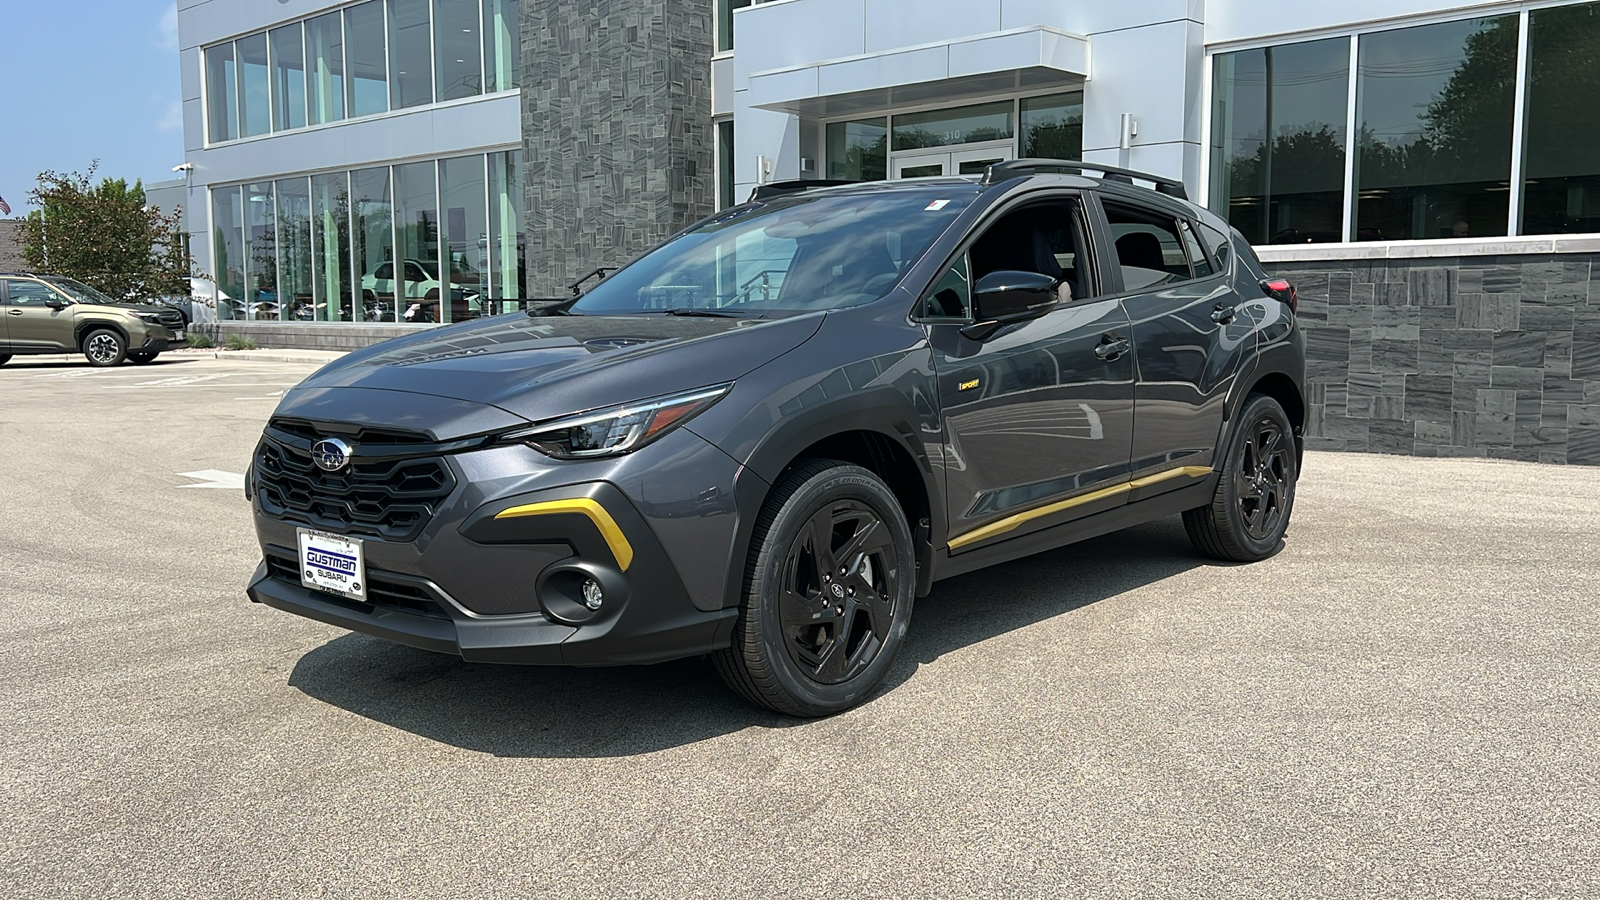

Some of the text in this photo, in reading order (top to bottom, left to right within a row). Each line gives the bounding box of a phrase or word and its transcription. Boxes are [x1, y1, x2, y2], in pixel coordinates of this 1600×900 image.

[944, 130, 960, 140] 310
[962, 379, 980, 390] SPORT
[317, 569, 347, 583] SUBARU
